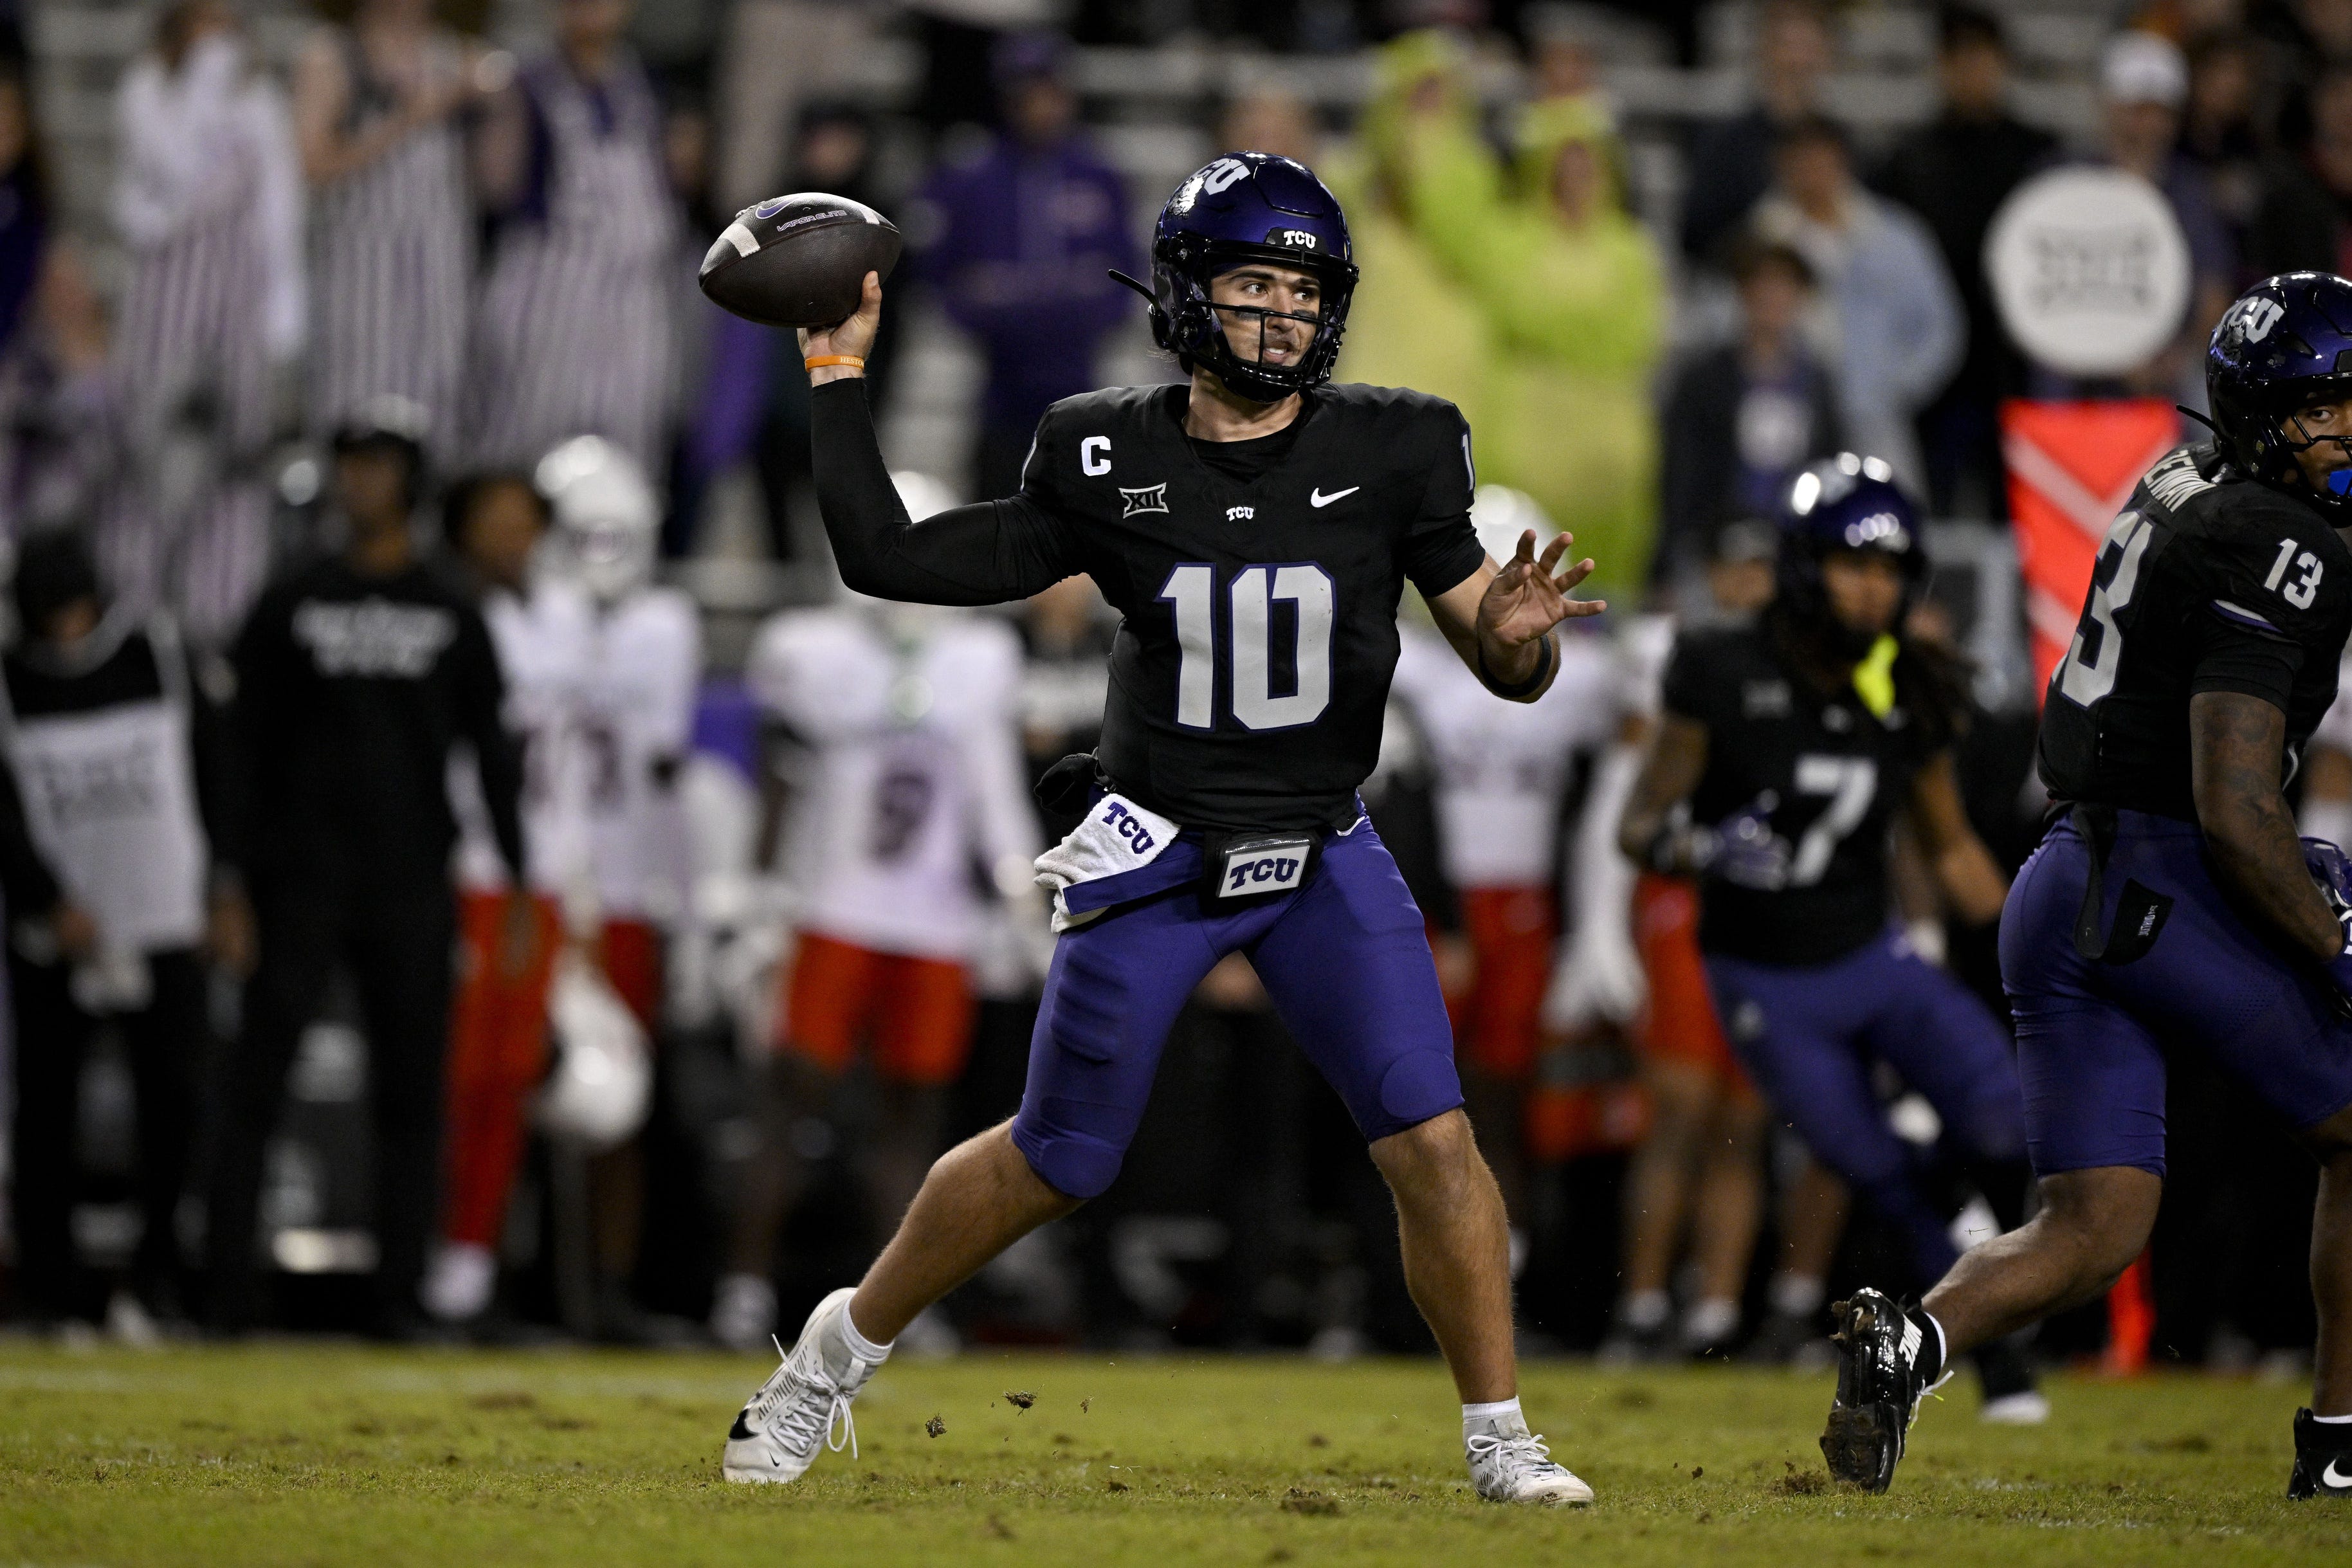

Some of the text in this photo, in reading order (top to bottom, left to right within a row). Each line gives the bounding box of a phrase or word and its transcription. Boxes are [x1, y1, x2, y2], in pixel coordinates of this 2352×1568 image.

[776, 210, 847, 232] VAPOR ELITE
[1284, 230, 1317, 249] TCU
[1080, 435, 1112, 477] C
[1118, 482, 1169, 518] XII
[1226, 506, 1254, 522] TCU
[2263, 538, 2324, 610] 13
[1155, 561, 1337, 732] 10
[1102, 801, 1154, 855] TCU
[1794, 754, 1877, 887] 7
[1229, 857, 1299, 891] TCU
